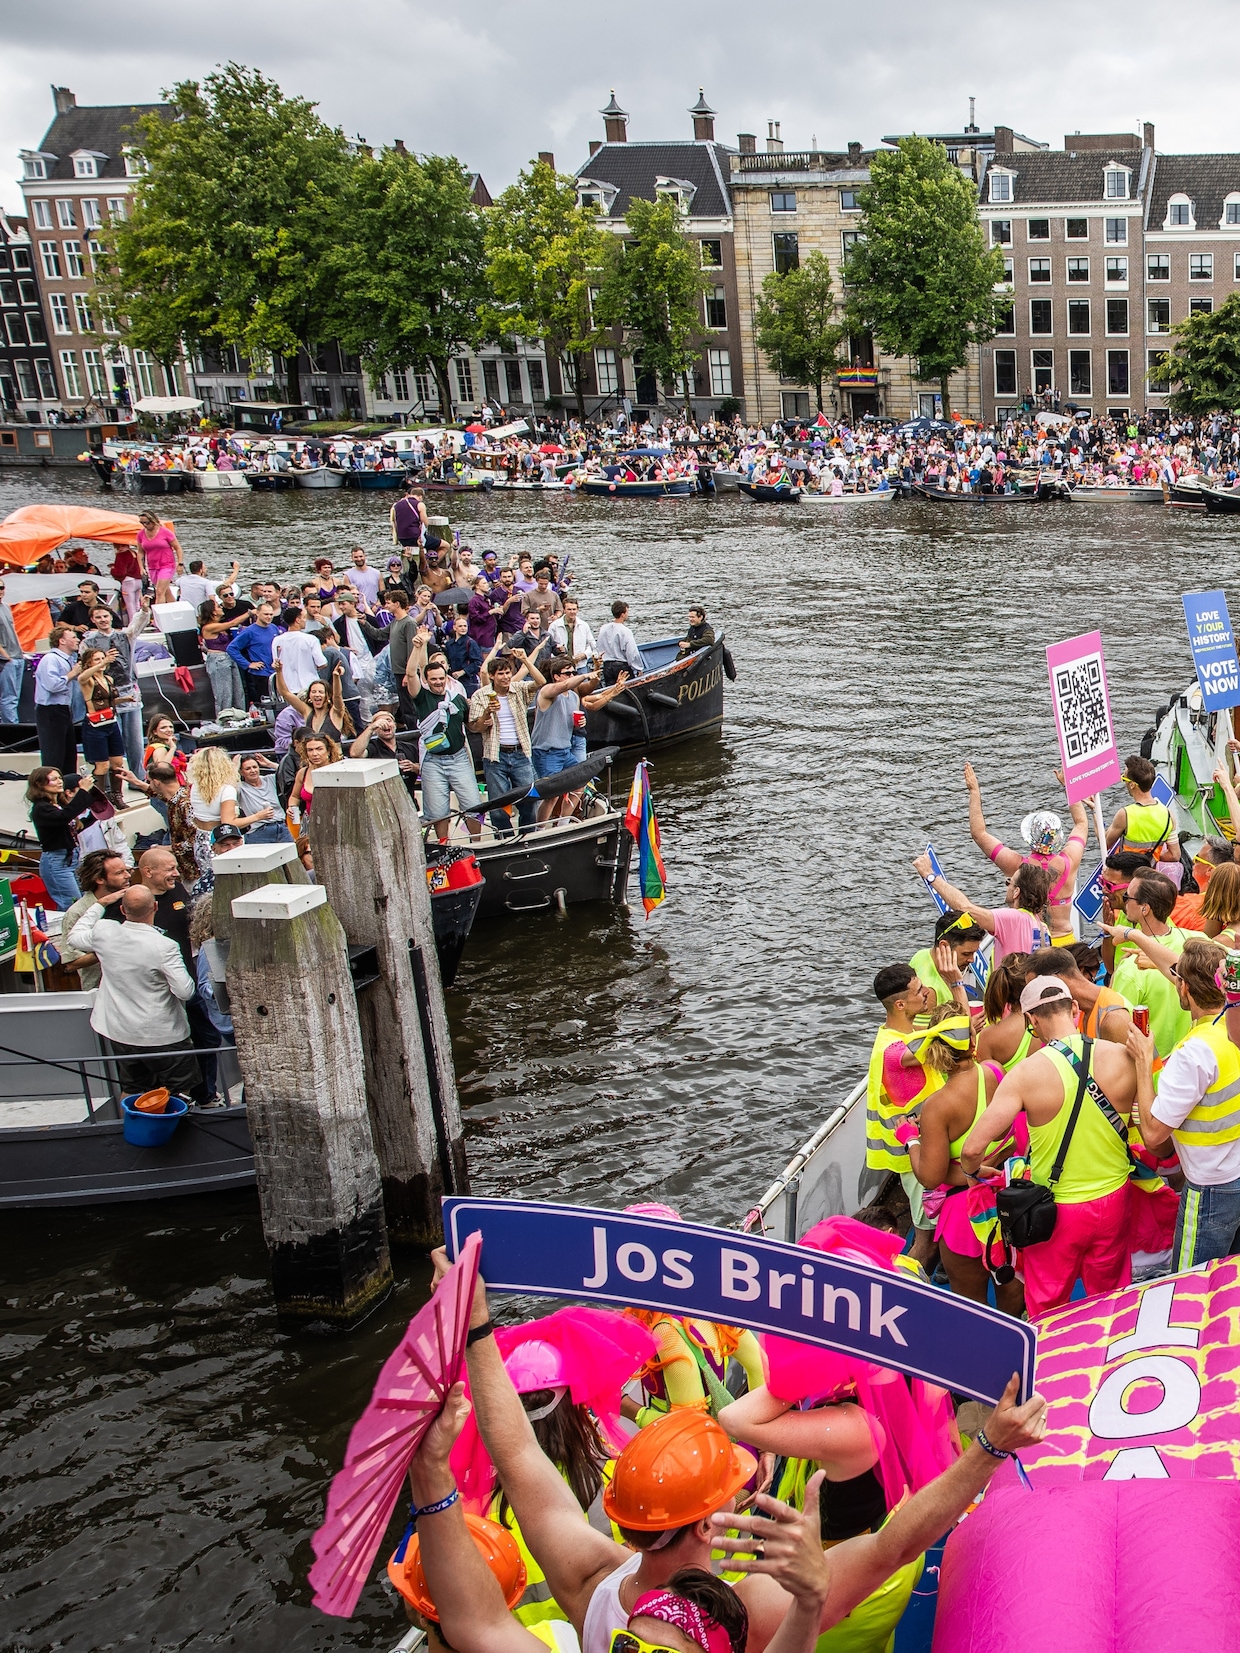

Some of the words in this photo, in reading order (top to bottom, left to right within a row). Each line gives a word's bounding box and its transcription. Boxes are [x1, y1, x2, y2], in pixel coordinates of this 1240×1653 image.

[1195, 610, 1220, 622] LOVE
[1196, 621, 1225, 634] Y/OUR
[1192, 632, 1231, 646] HISTORY
[1199, 659, 1238, 679] VOTE
[677, 661, 722, 706] POLLUX
[1204, 675, 1239, 696] NOW
[582, 1226, 696, 1290] Jos
[720, 1247, 909, 1347] Brink
[422, 1500, 450, 1513] LOVE
